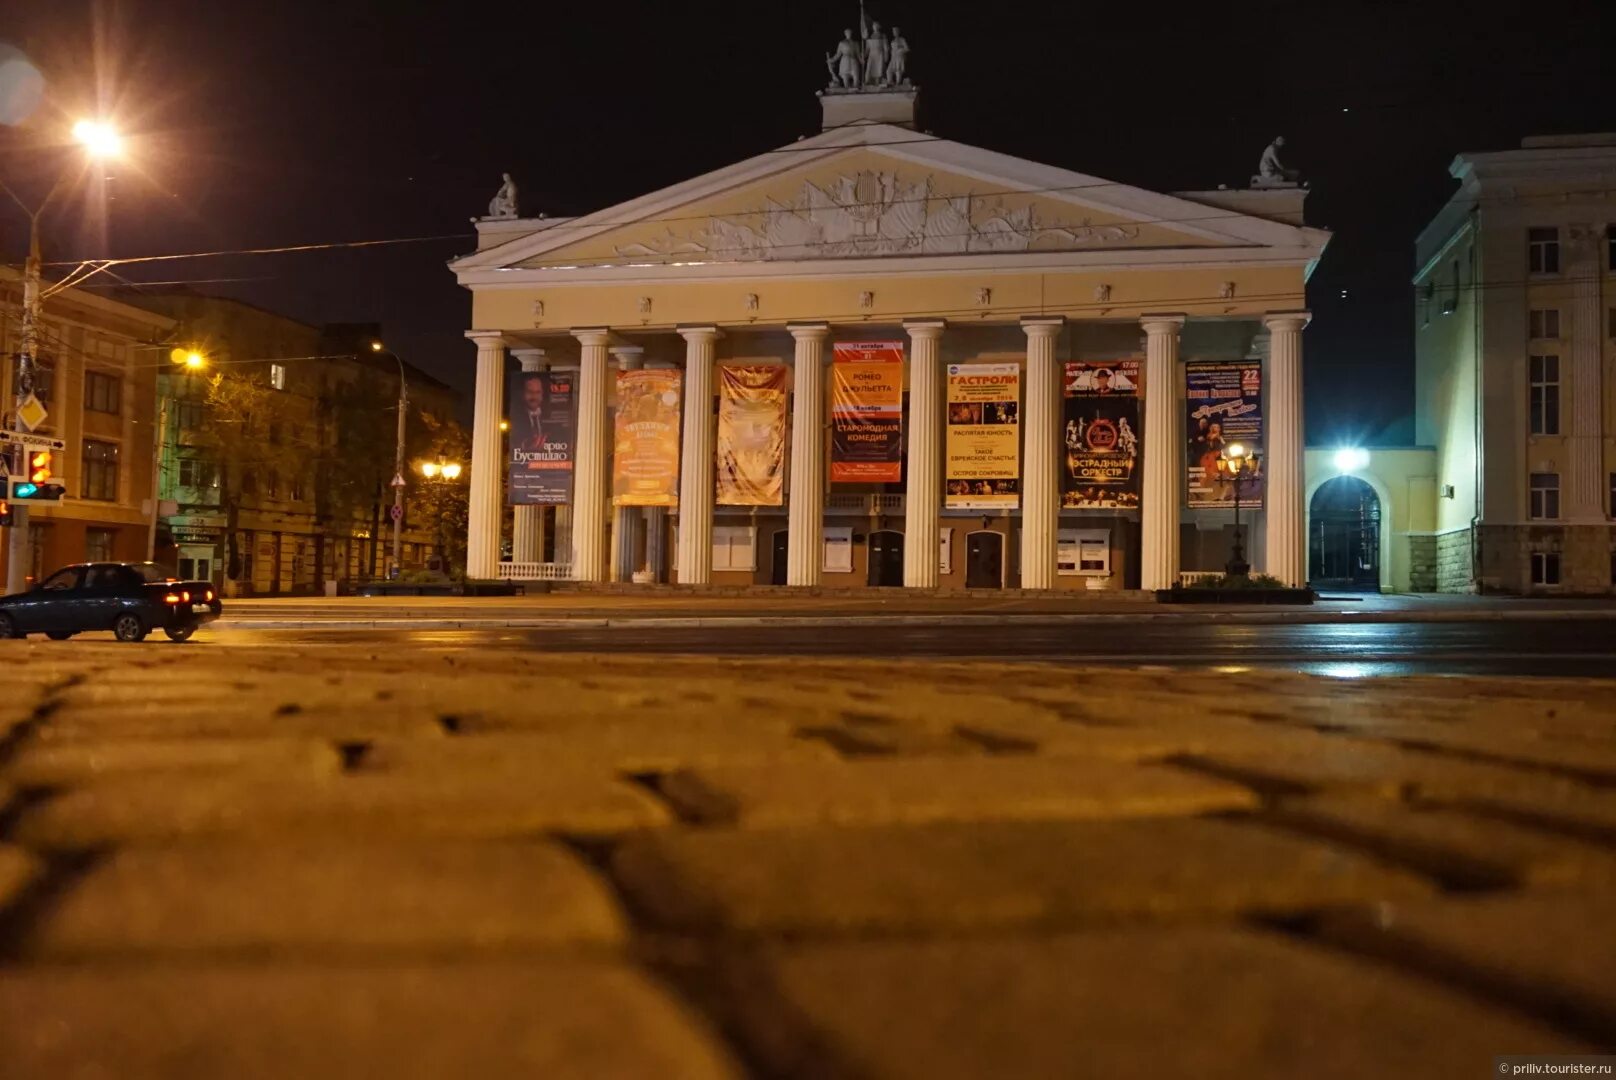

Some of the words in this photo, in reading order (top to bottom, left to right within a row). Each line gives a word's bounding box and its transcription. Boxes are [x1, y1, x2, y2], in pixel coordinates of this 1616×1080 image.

[853, 373, 882, 381] РОМЕО
[1243, 370, 1258, 380] 22
[950, 376, 1018, 385] ГАСТРОЛИ
[842, 385, 892, 393] ДЖУЛЬЕТТА
[837, 424, 899, 433] СТАРОМОДНАЯ
[22, 436, 52, 446] ФОКИНА
[847, 434, 888, 442] КОМЕДИЯ
[513, 447, 568, 465] Бустилло
[1072, 459, 1130, 468] ЭСТРАДНЫЙ
[1081, 468, 1122, 477] ОРКЕСТР
